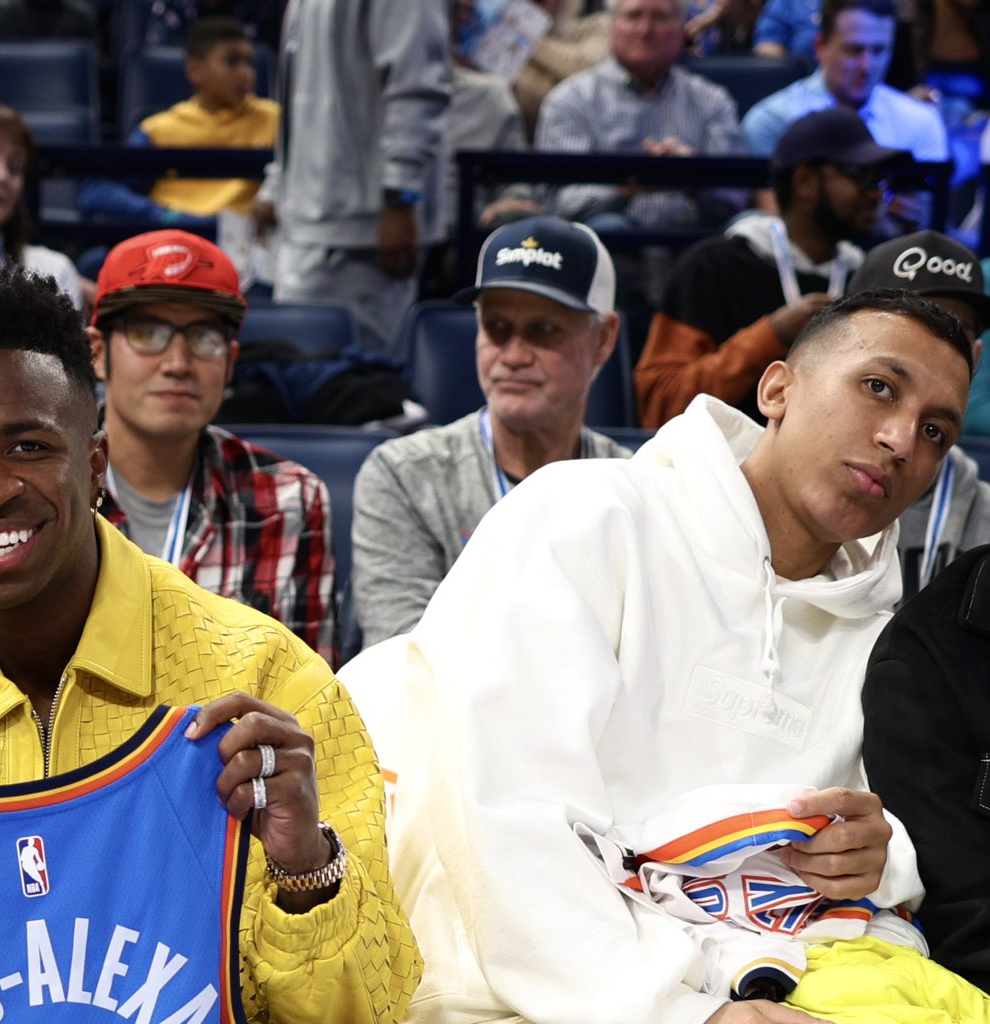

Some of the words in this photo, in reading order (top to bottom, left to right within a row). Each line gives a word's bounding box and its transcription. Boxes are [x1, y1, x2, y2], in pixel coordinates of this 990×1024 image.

[495, 247, 563, 270] Simplot
[699, 676, 805, 738] Suprme
[26, 882, 41, 894] NBA
